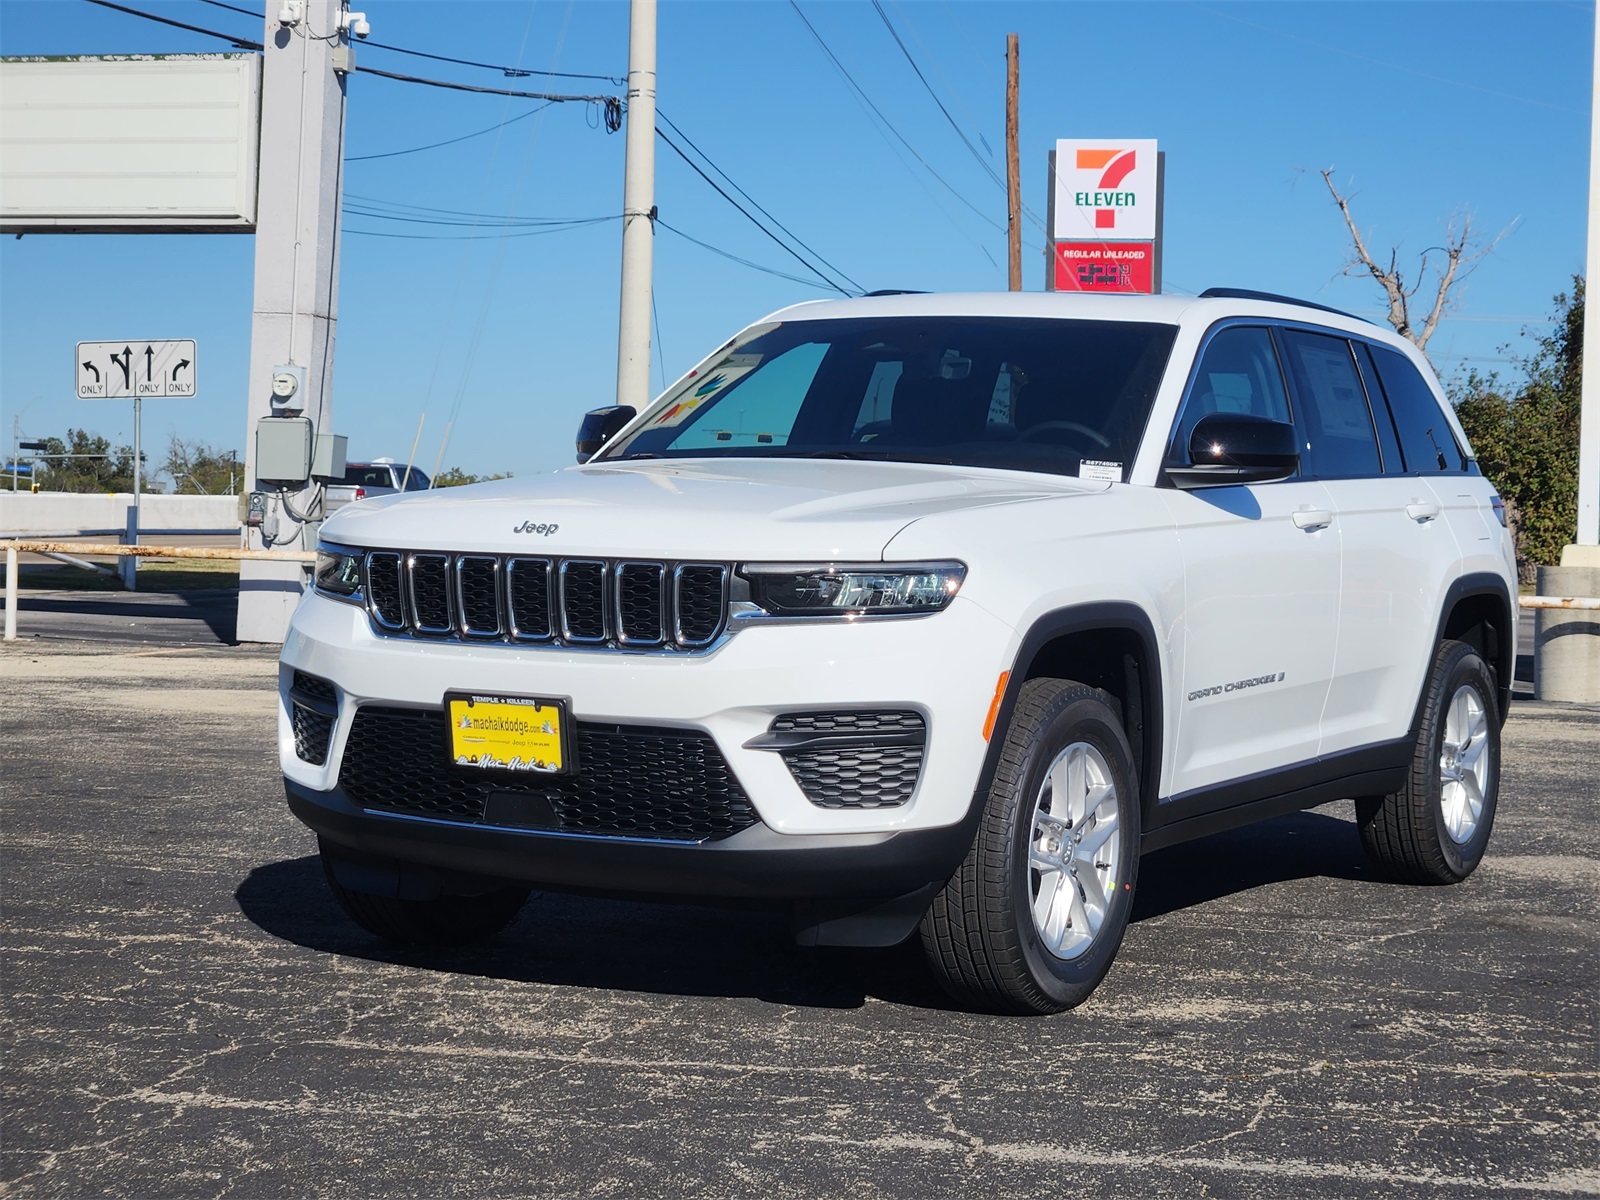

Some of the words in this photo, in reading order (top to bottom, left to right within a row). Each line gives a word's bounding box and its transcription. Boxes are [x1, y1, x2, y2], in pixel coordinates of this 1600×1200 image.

[1076, 149, 1136, 189] 7
[1064, 250, 1101, 258] REGULAR
[1103, 250, 1145, 259] UNLEADED
[81, 385, 103, 394] ONLY
[139, 384, 160, 393] ONLY
[168, 383, 192, 393] ONLY
[513, 520, 560, 537] Jeep
[1188, 685, 1223, 701] GRAND
[1224, 673, 1277, 693] CHEROKEE
[472, 696, 499, 704] TEMPLE
[507, 698, 535, 706] KILLEEN
[473, 716, 541, 735] machaikdodge.com
[478, 754, 503, 769] Mac
[507, 756, 537, 771] Haik
